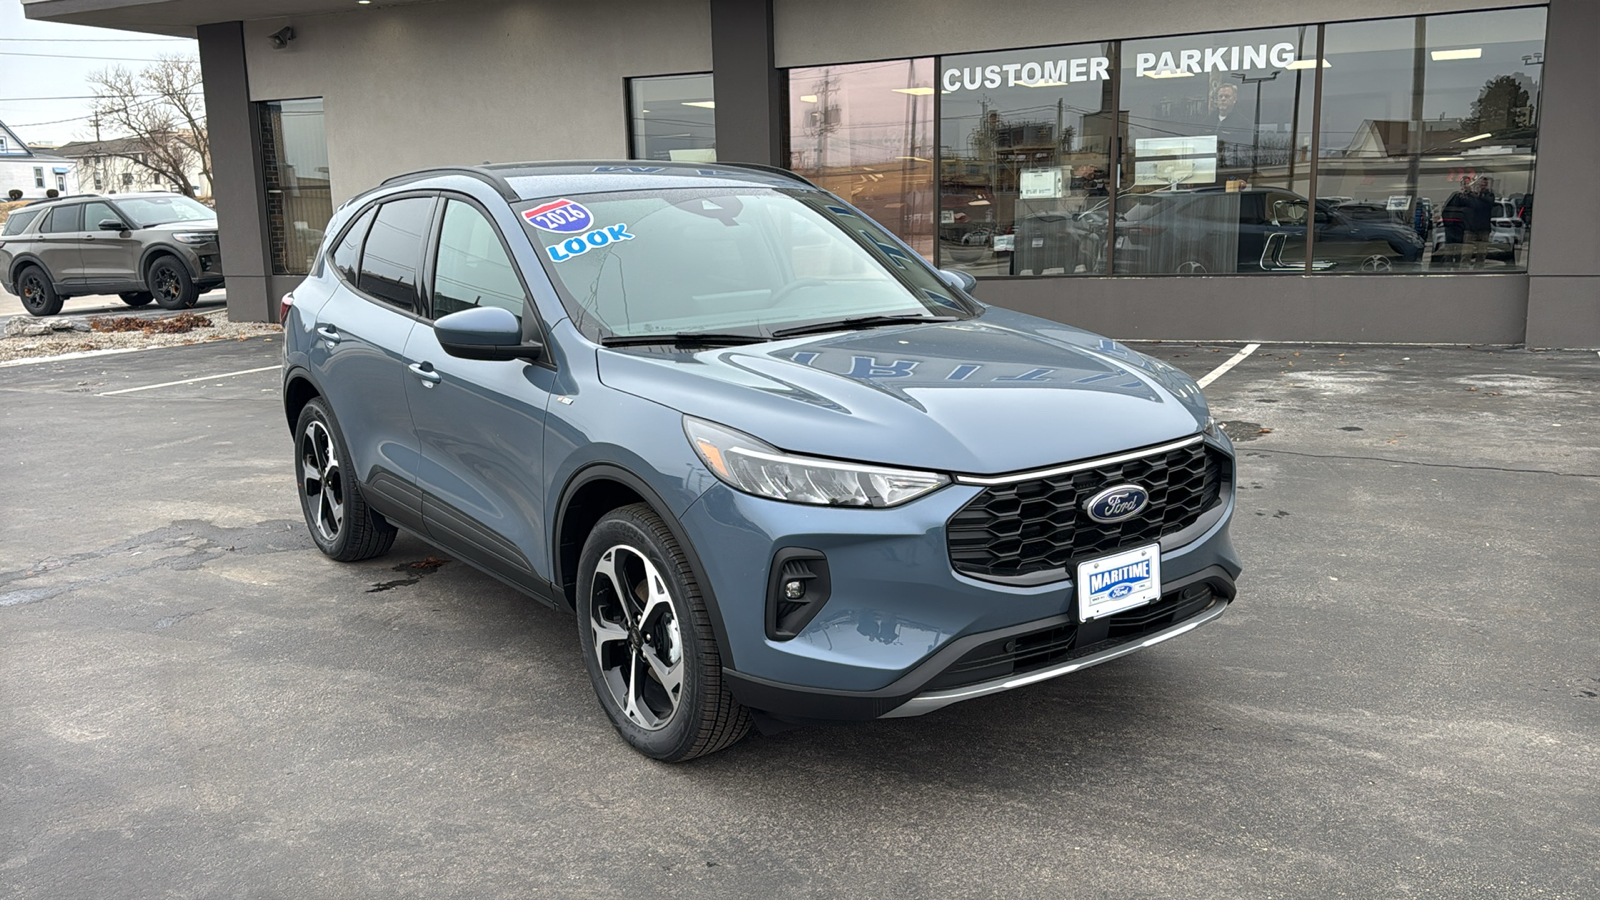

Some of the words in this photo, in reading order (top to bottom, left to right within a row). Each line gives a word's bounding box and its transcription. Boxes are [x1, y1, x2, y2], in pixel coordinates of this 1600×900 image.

[942, 56, 1110, 92] CUSTOMER
[1136, 42, 1295, 78] PARKING
[536, 206, 586, 229] 2026
[547, 224, 634, 261] LOOK
[1104, 492, 1138, 517] Ford
[1090, 560, 1149, 594] MARITIME
[1111, 585, 1130, 598] Ford
